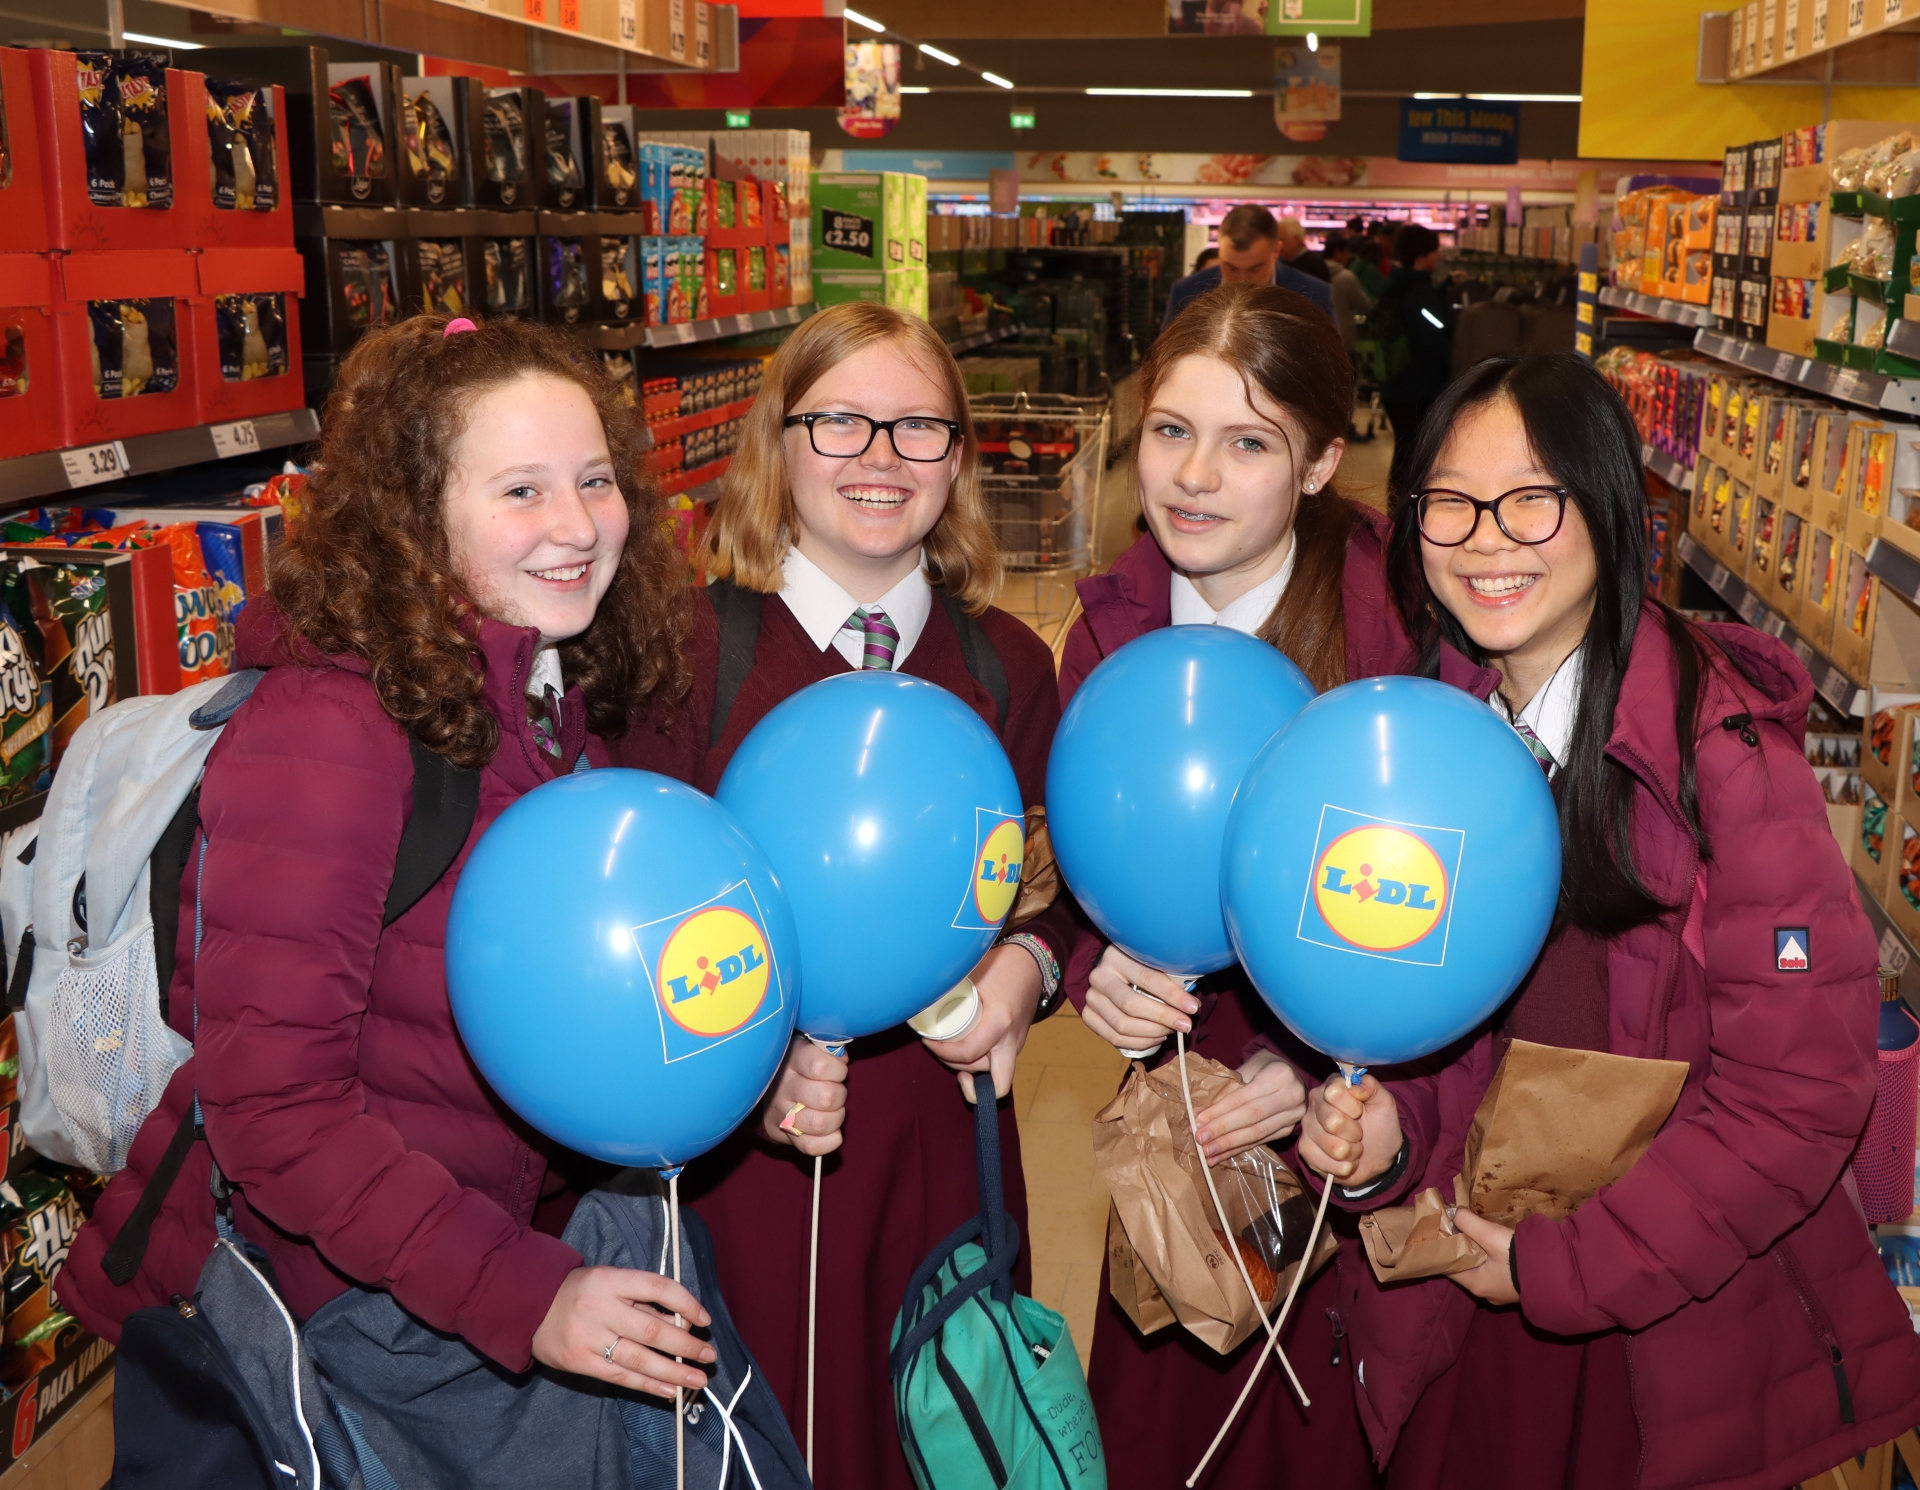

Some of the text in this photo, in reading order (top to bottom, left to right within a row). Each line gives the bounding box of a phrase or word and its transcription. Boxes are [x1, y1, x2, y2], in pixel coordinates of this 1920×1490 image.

[825, 229, 870, 248] €2.50
[234, 424, 256, 446] 4.75
[89, 448, 118, 476] 3.29
[12, 1376, 39, 1459] 6
[37, 1360, 77, 1423] PACK
